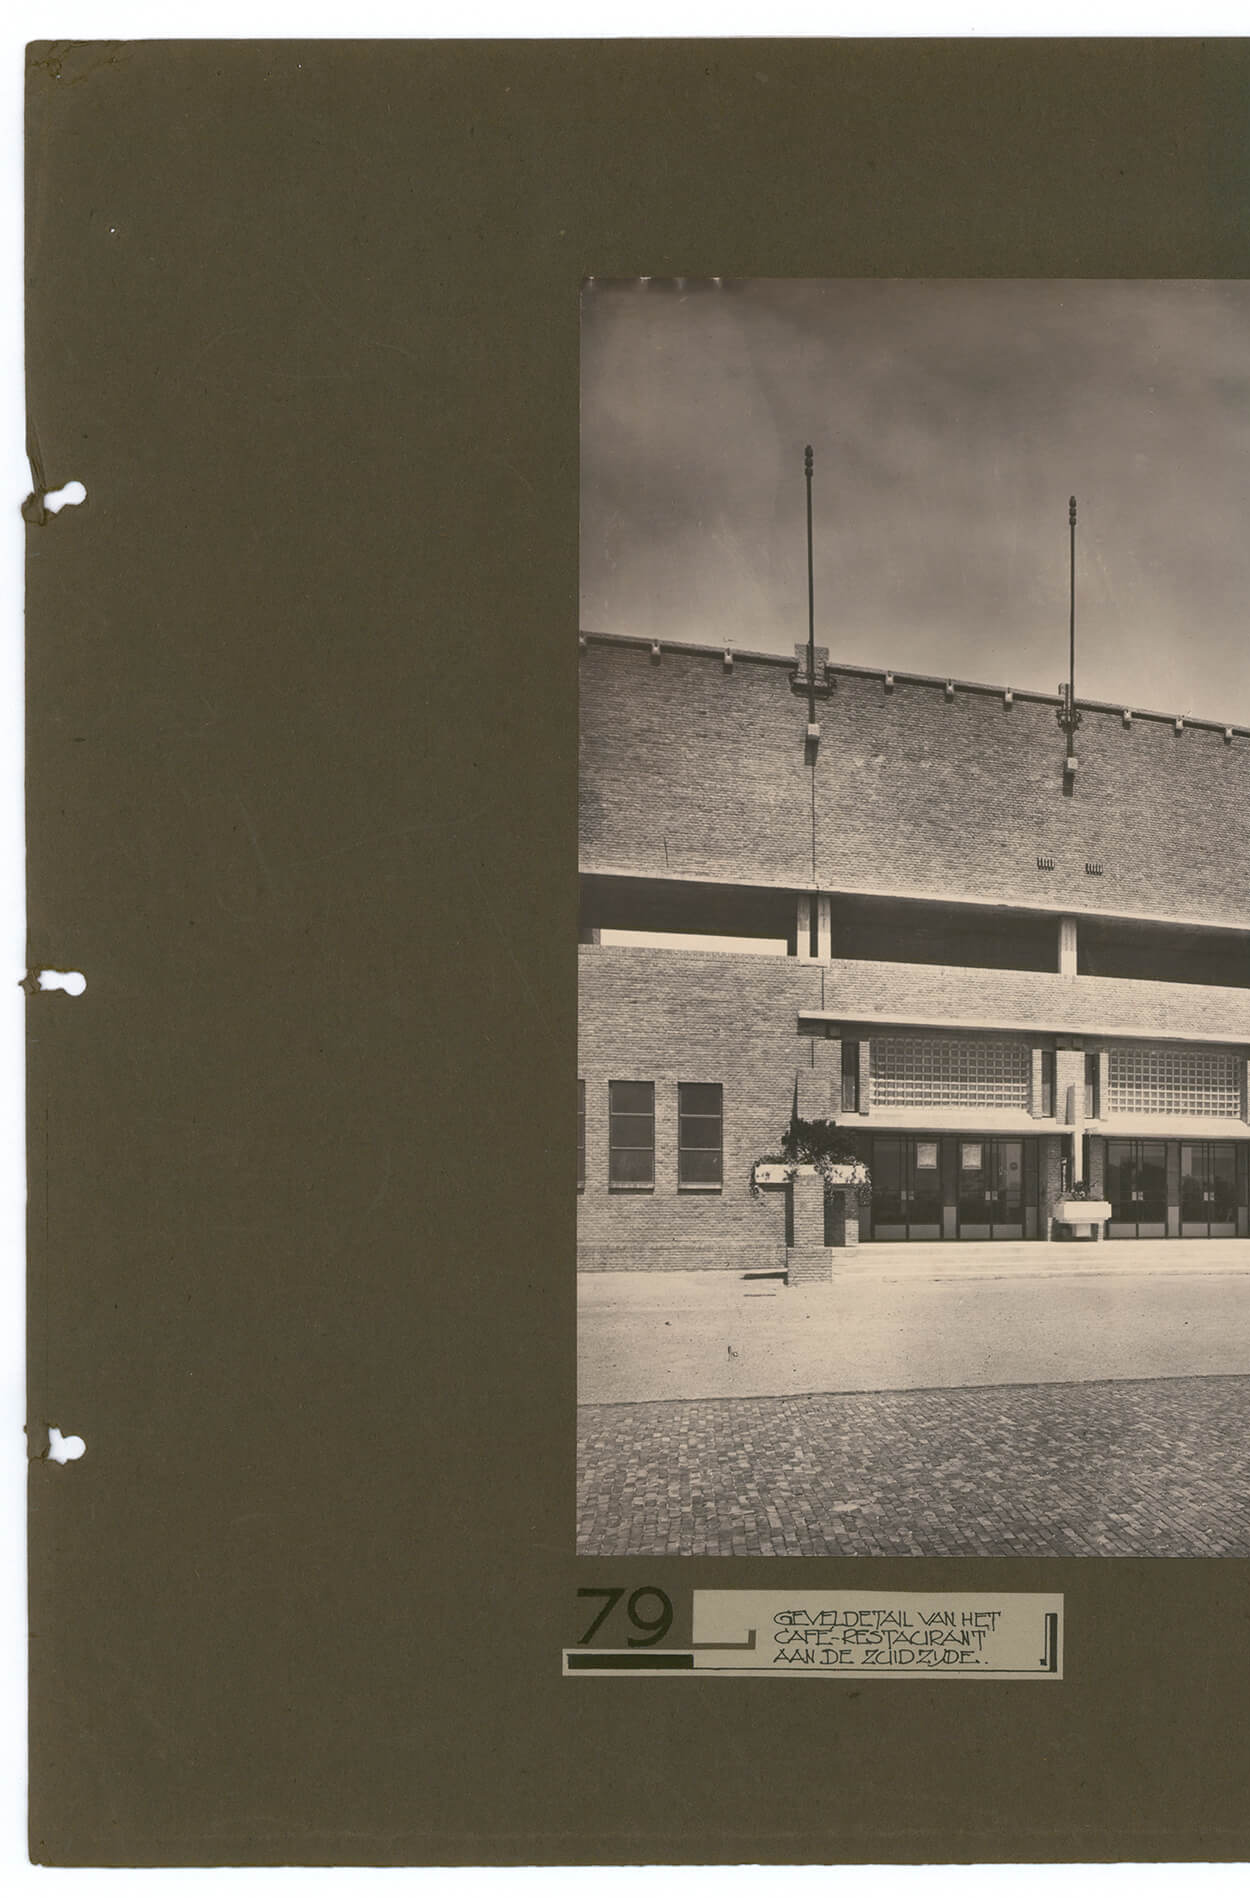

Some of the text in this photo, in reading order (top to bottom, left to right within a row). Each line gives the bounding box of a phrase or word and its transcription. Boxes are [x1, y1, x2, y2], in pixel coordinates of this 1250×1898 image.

[773, 1610, 1001, 1632] GEVELDETAIL VAN HET
[773, 1648, 815, 1664] AAN
[819, 1648, 855, 1665] DE
